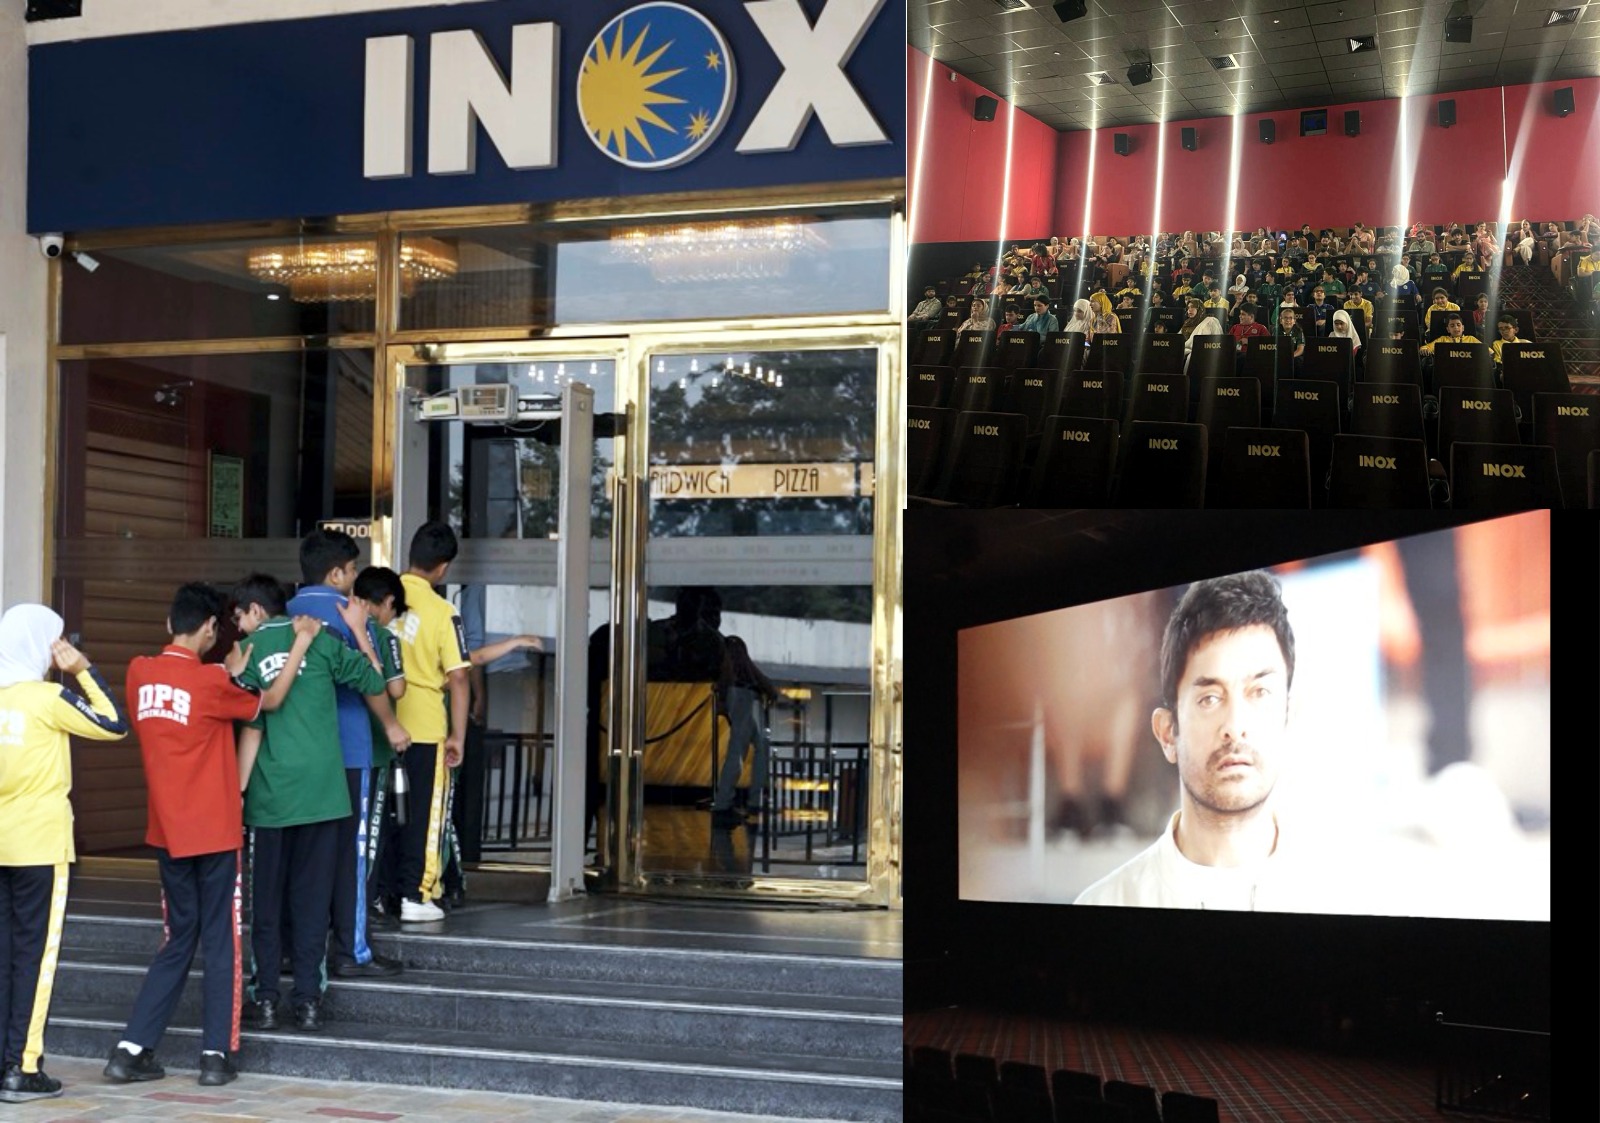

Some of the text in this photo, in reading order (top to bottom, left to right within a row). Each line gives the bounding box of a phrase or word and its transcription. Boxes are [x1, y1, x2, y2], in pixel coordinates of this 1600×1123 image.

[1024, 379, 1043, 387] INOX
[1082, 381, 1103, 389] INOX
[1147, 384, 1169, 393] INOX
[1217, 388, 1240, 397] INOX
[1294, 391, 1319, 401] INOX
[1372, 395, 1399, 404] INOX
[1461, 401, 1492, 411] INOX
[1557, 407, 1589, 417] INOX
[908, 419, 931, 430] INOX
[973, 426, 999, 436] INOX
[1062, 431, 1090, 443] INOX
[1148, 439, 1179, 451] INOX
[1247, 445, 1281, 457] INOX
[1359, 455, 1397, 470] INOX
[1482, 463, 1526, 478] INOX
[650, 468, 820, 494] ANDWICH PIZZA
[138, 684, 191, 717] DPS
